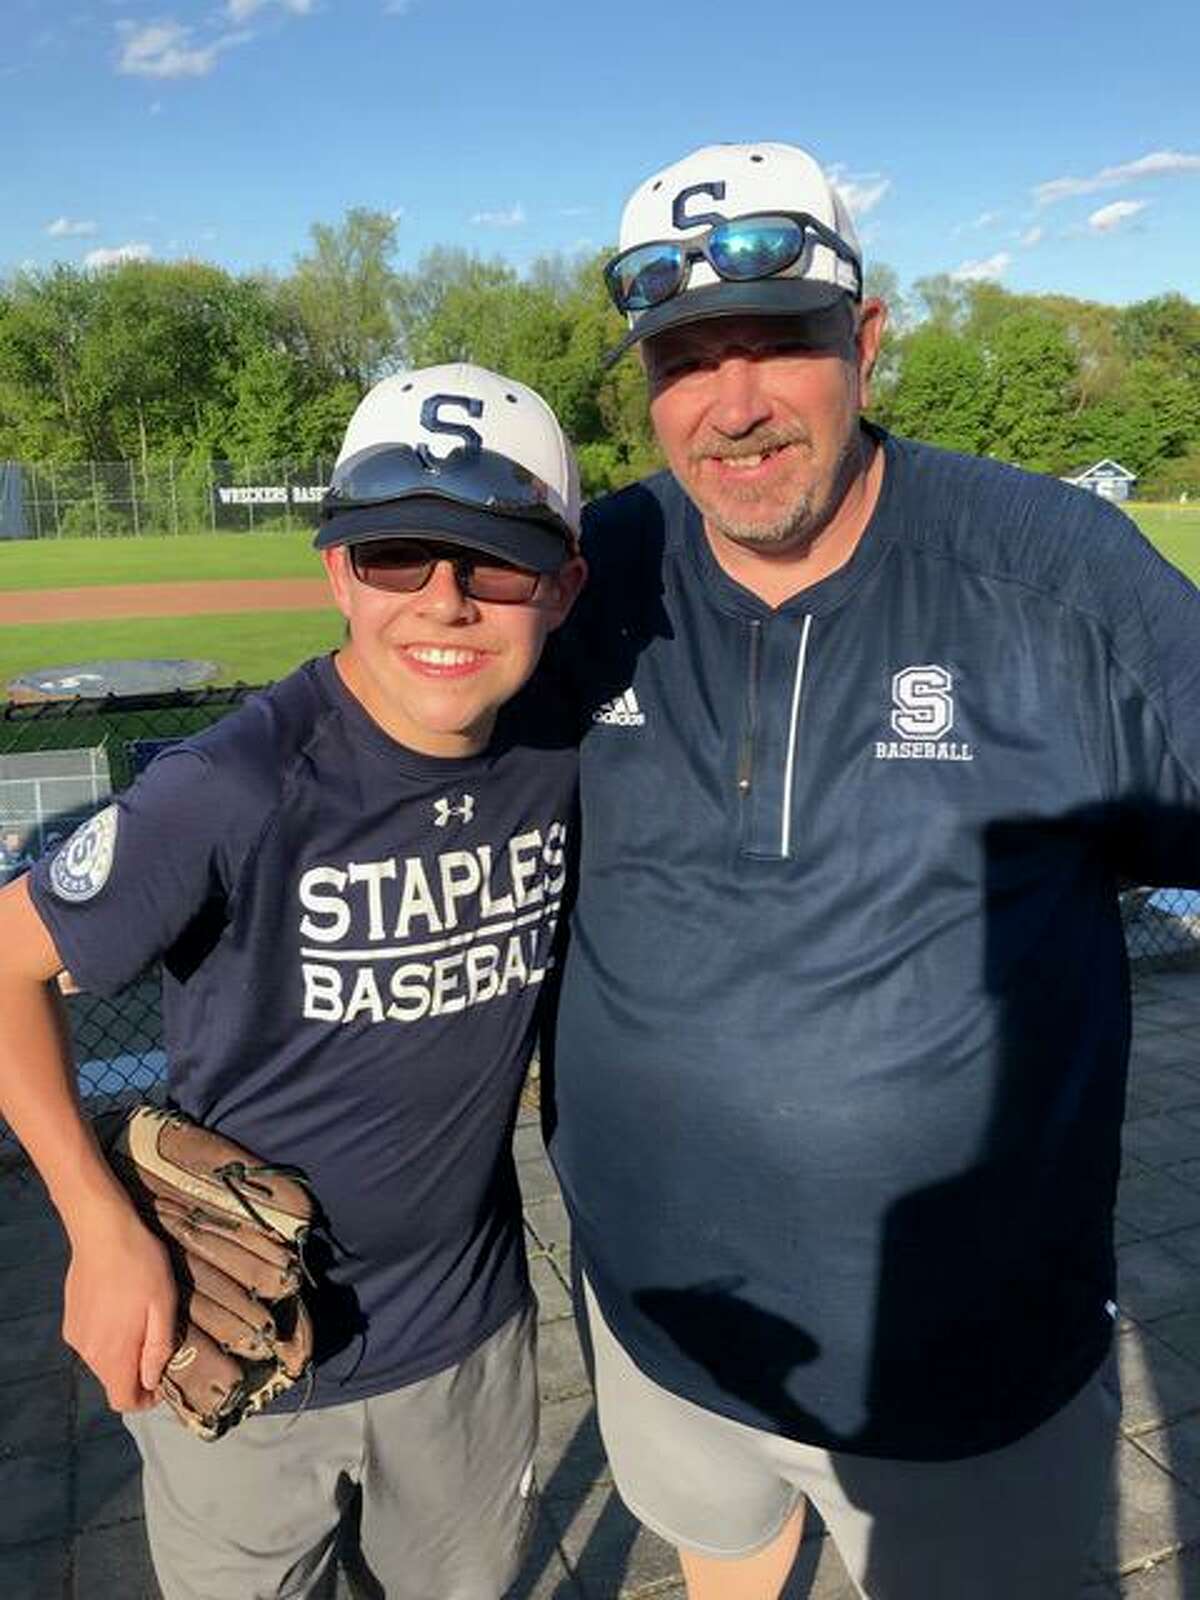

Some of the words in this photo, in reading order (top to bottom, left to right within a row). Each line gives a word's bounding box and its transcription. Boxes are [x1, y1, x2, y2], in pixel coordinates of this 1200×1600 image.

[672, 180, 727, 231] S
[419, 393, 483, 456] S
[219, 486, 288, 504] WRECKERS
[292, 486, 329, 503] BASE
[892, 666, 953, 740] S
[875, 741, 974, 761] BASEBALL
[299, 822, 567, 943] STAPLES
